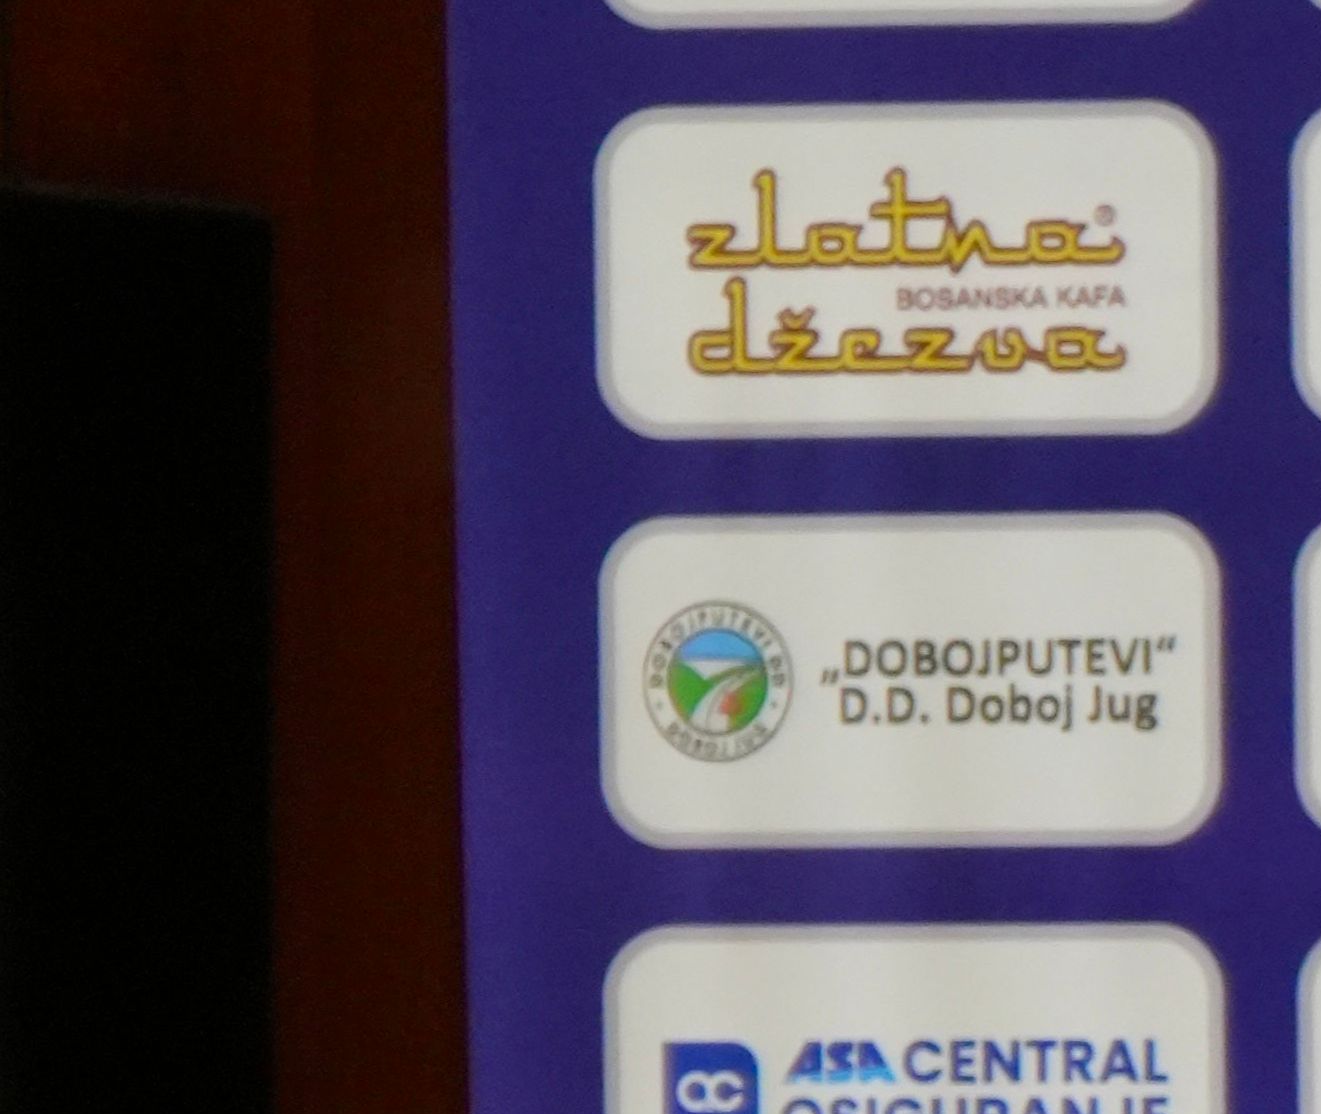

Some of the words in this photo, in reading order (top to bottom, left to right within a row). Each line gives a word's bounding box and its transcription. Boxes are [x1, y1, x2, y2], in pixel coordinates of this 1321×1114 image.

[897, 287, 1048, 311] BOSANSKA
[1056, 286, 1126, 309] KAFA
[688, 276, 1127, 375] džezva
[840, 687, 931, 725] D.D.
[946, 685, 1073, 733] Doboj
[1086, 686, 1160, 731] Jug
[784, 1041, 897, 1084] ASA
[904, 1039, 1170, 1084] CENTRAL
